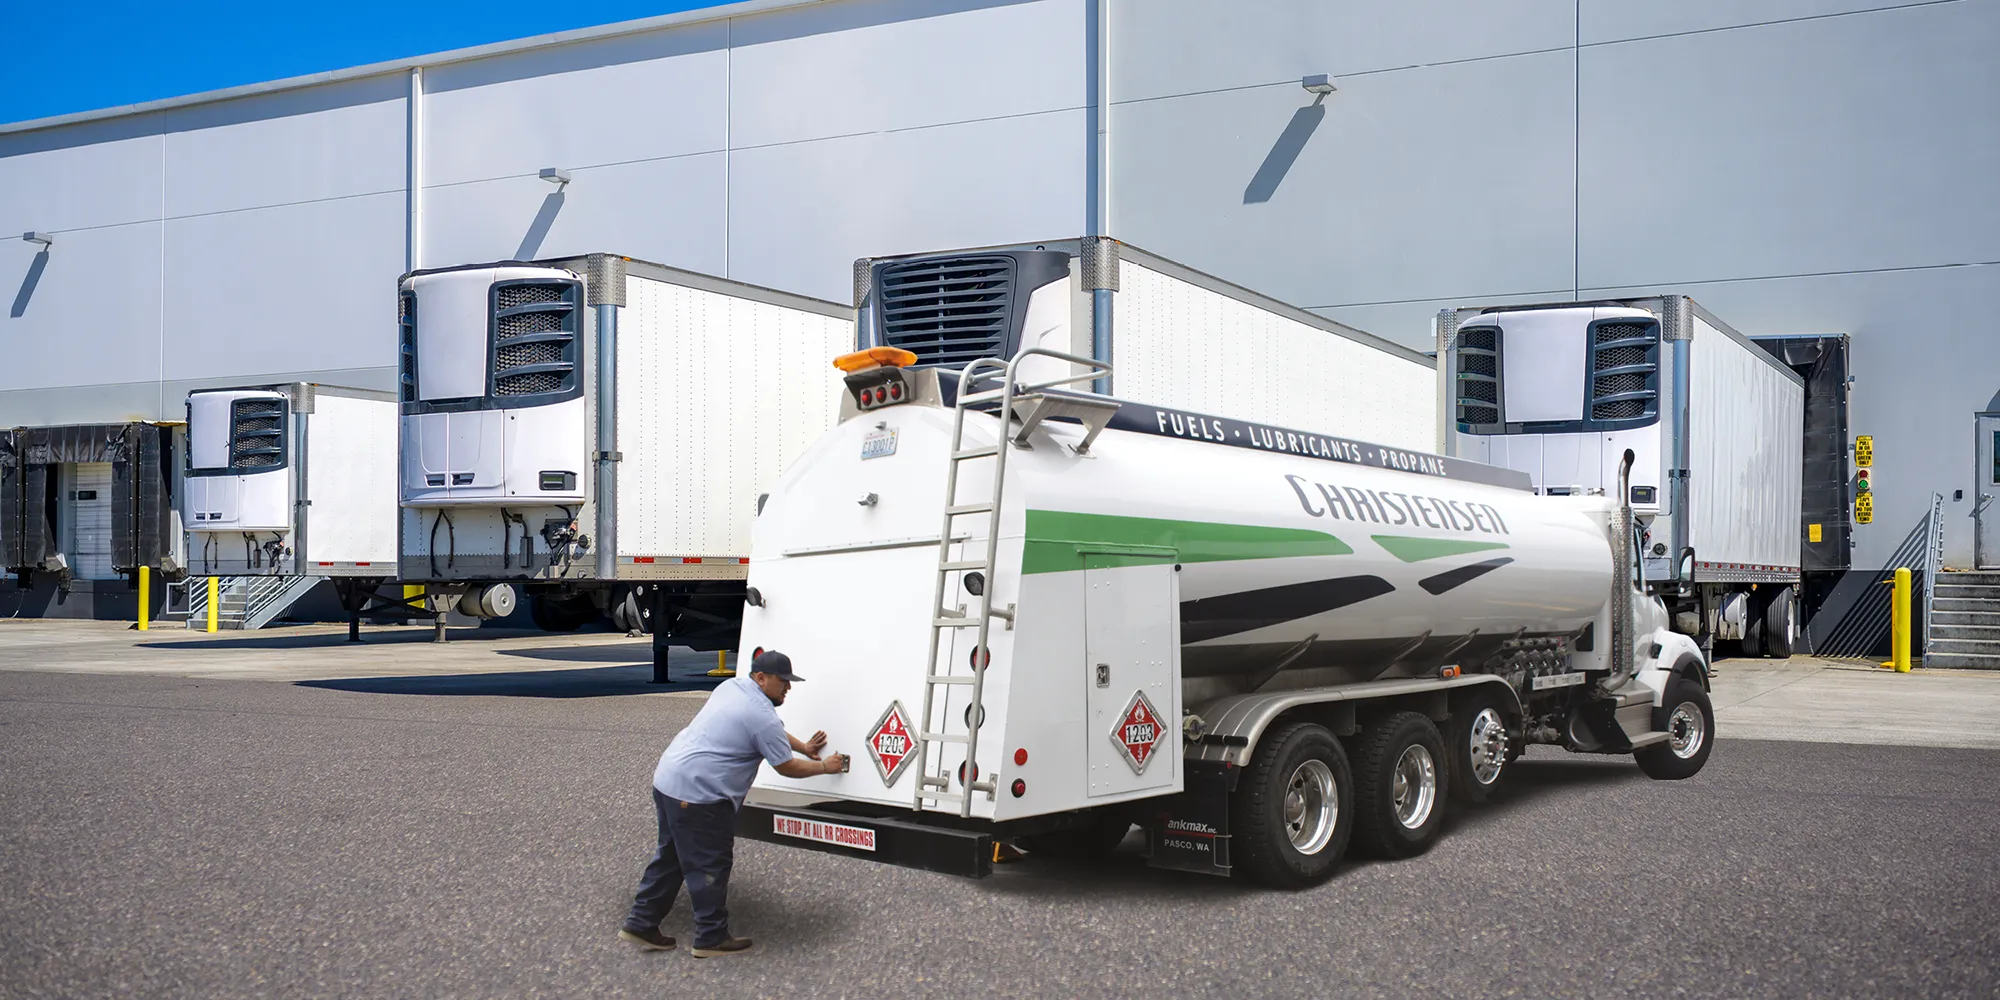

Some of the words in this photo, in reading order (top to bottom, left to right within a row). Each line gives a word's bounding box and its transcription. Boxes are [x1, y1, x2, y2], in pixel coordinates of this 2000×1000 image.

[1156, 411, 1225, 442] FUELS
[1248, 426, 1362, 463] LUBRICANTS
[1379, 449, 1447, 476] PROPANE
[1284, 474, 1510, 535] CHRISTENSEN
[880, 735, 904, 754] 1203
[1127, 724, 1153, 743] 1203
[776, 818, 785, 833] WE
[787, 820, 801, 835] STOP
[804, 822, 811, 837] AT
[813, 823, 823, 839] ALL
[825, 825, 833, 841] RR
[835, 827, 873, 847] CROSSINGS
[1164, 839, 1195, 851] PASCO,
[1196, 843, 1209, 851] WA
